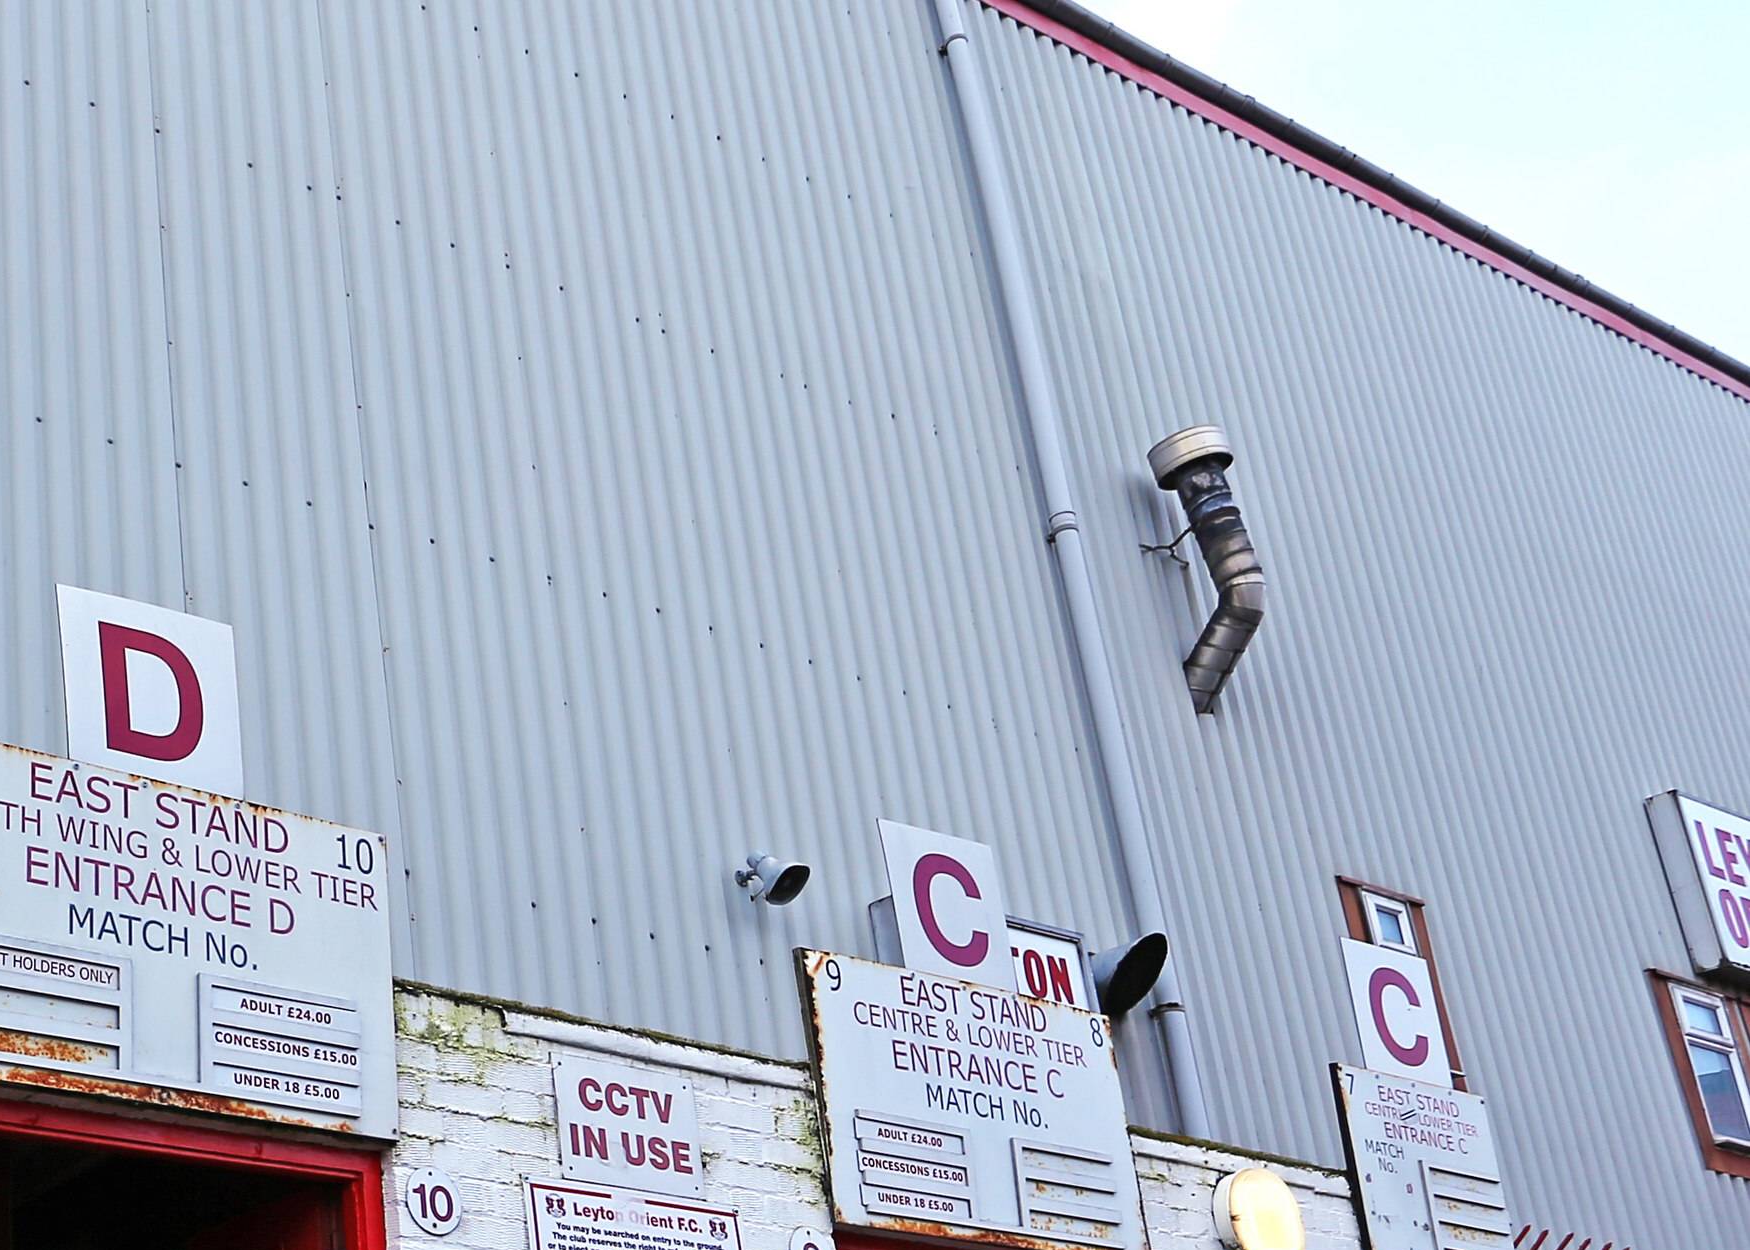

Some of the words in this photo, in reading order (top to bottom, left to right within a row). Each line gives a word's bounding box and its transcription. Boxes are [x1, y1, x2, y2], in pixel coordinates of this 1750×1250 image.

[97, 620, 205, 762] D
[30, 761, 139, 819] EAST
[155, 792, 289, 855] STAND
[56, 813, 148, 859] WING
[161, 838, 182, 866] &
[195, 844, 301, 895] LOWER
[311, 871, 378, 912] TIER
[336, 834, 374, 875] 10
[26, 847, 252, 929] ENTRANCE
[269, 897, 296, 936] D
[913, 853, 989, 968] C
[69, 903, 190, 958] MATCH
[205, 931, 259, 971] No.
[13, 954, 75, 981] HOLDERS
[79, 966, 114, 986] ONLY
[826, 959, 841, 992] 9
[1011, 946, 1075, 1005] ON
[240, 997, 283, 1017] ADULT
[287, 1005, 332, 1026] £24.00
[900, 976, 961, 1011] EAST
[972, 993, 1047, 1033] STAND
[1368, 967, 1429, 1067] C
[214, 1030, 310, 1059] CONCESSIONS
[314, 1047, 358, 1066] £15.00
[853, 1001, 938, 1039] CENTRE
[946, 1020, 961, 1042] &
[967, 1024, 1036, 1058] LOWER
[1042, 1039, 1087, 1068] TIER
[1091, 1018, 1104, 1048] 8
[234, 1072, 283, 1093] UNDER
[287, 1079, 300, 1094] 18
[304, 1082, 340, 1100] £5.00
[892, 1041, 1038, 1094] ENTRANCE
[1047, 1068, 1065, 1099] C
[578, 1077, 673, 1124] CCTV
[926, 1083, 1004, 1121] MATCH
[1014, 1100, 1049, 1129] No.
[1365, 1102, 1403, 1121] CENTR
[1418, 1114, 1453, 1131] LOWER
[1455, 1121, 1478, 1138] TIER
[1377, 1085, 1410, 1105] EAST
[1416, 1094, 1459, 1118] STAND
[570, 1123, 609, 1160] IN
[621, 1132, 693, 1174] USE
[877, 1127, 908, 1142] ADULT
[910, 1133, 943, 1148] £24.00
[1365, 1139, 1405, 1159] MATCH
[1384, 1122, 1455, 1151] ENTRANCE
[1459, 1138, 1468, 1154] C
[861, 1156, 930, 1177] CONCESSIONS
[933, 1167, 964, 1183] £15.00
[1378, 1157, 1398, 1173] No.
[411, 1183, 454, 1223] 10
[878, 1192, 911, 1207] UNDER
[914, 1196, 925, 1208] 18
[928, 1199, 954, 1213] £5.00
[677, 1217, 702, 1233] F.C.
